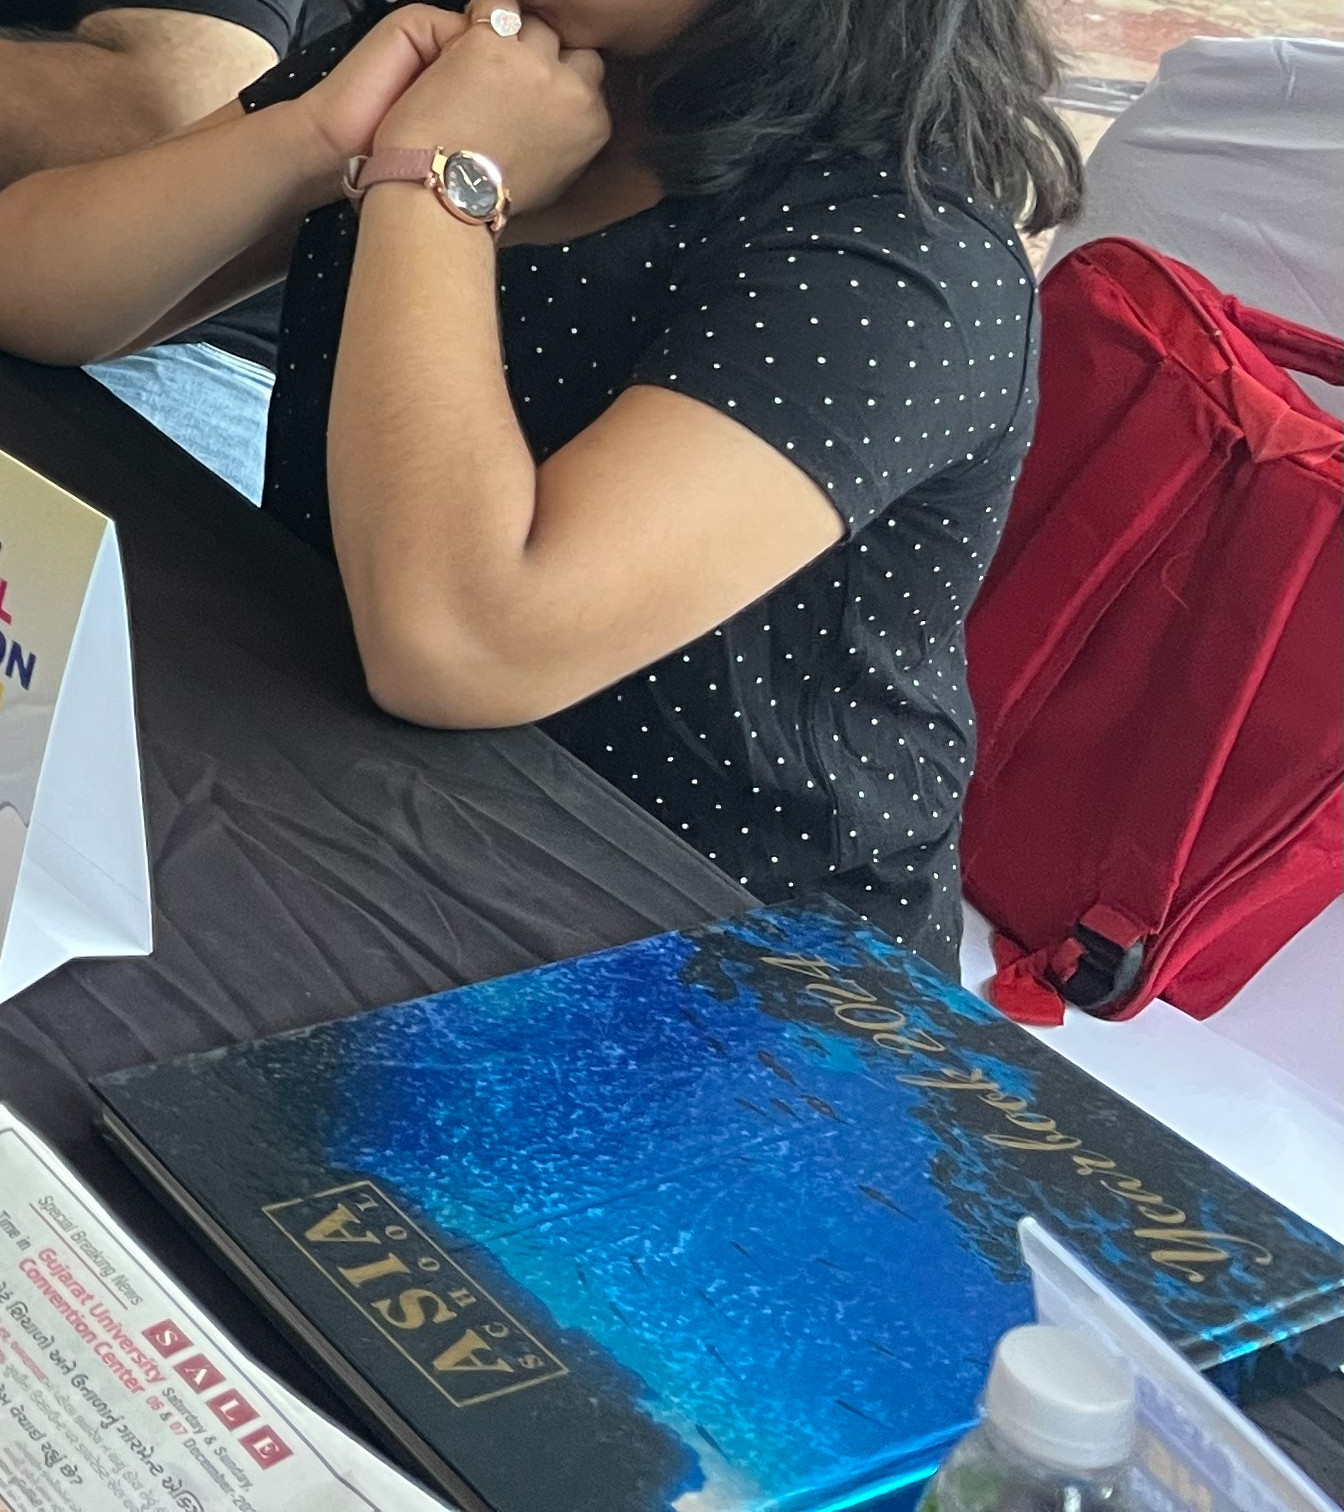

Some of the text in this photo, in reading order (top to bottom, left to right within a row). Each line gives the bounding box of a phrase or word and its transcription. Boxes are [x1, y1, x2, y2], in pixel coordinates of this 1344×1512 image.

[33, 1194, 146, 1306] Special Breaking News
[305, 1203, 514, 1373] ASIA
[355, 1192, 544, 1370] SCHOOL
[14, 1236, 36, 1250] in
[33, 1247, 98, 1306] Gujarat
[84, 1302, 169, 1386] University
[159, 1386, 207, 1435] Saturday
[202, 1435, 217, 1445] &
[14, 1257, 188, 1437] Convention Center 06 & 07
